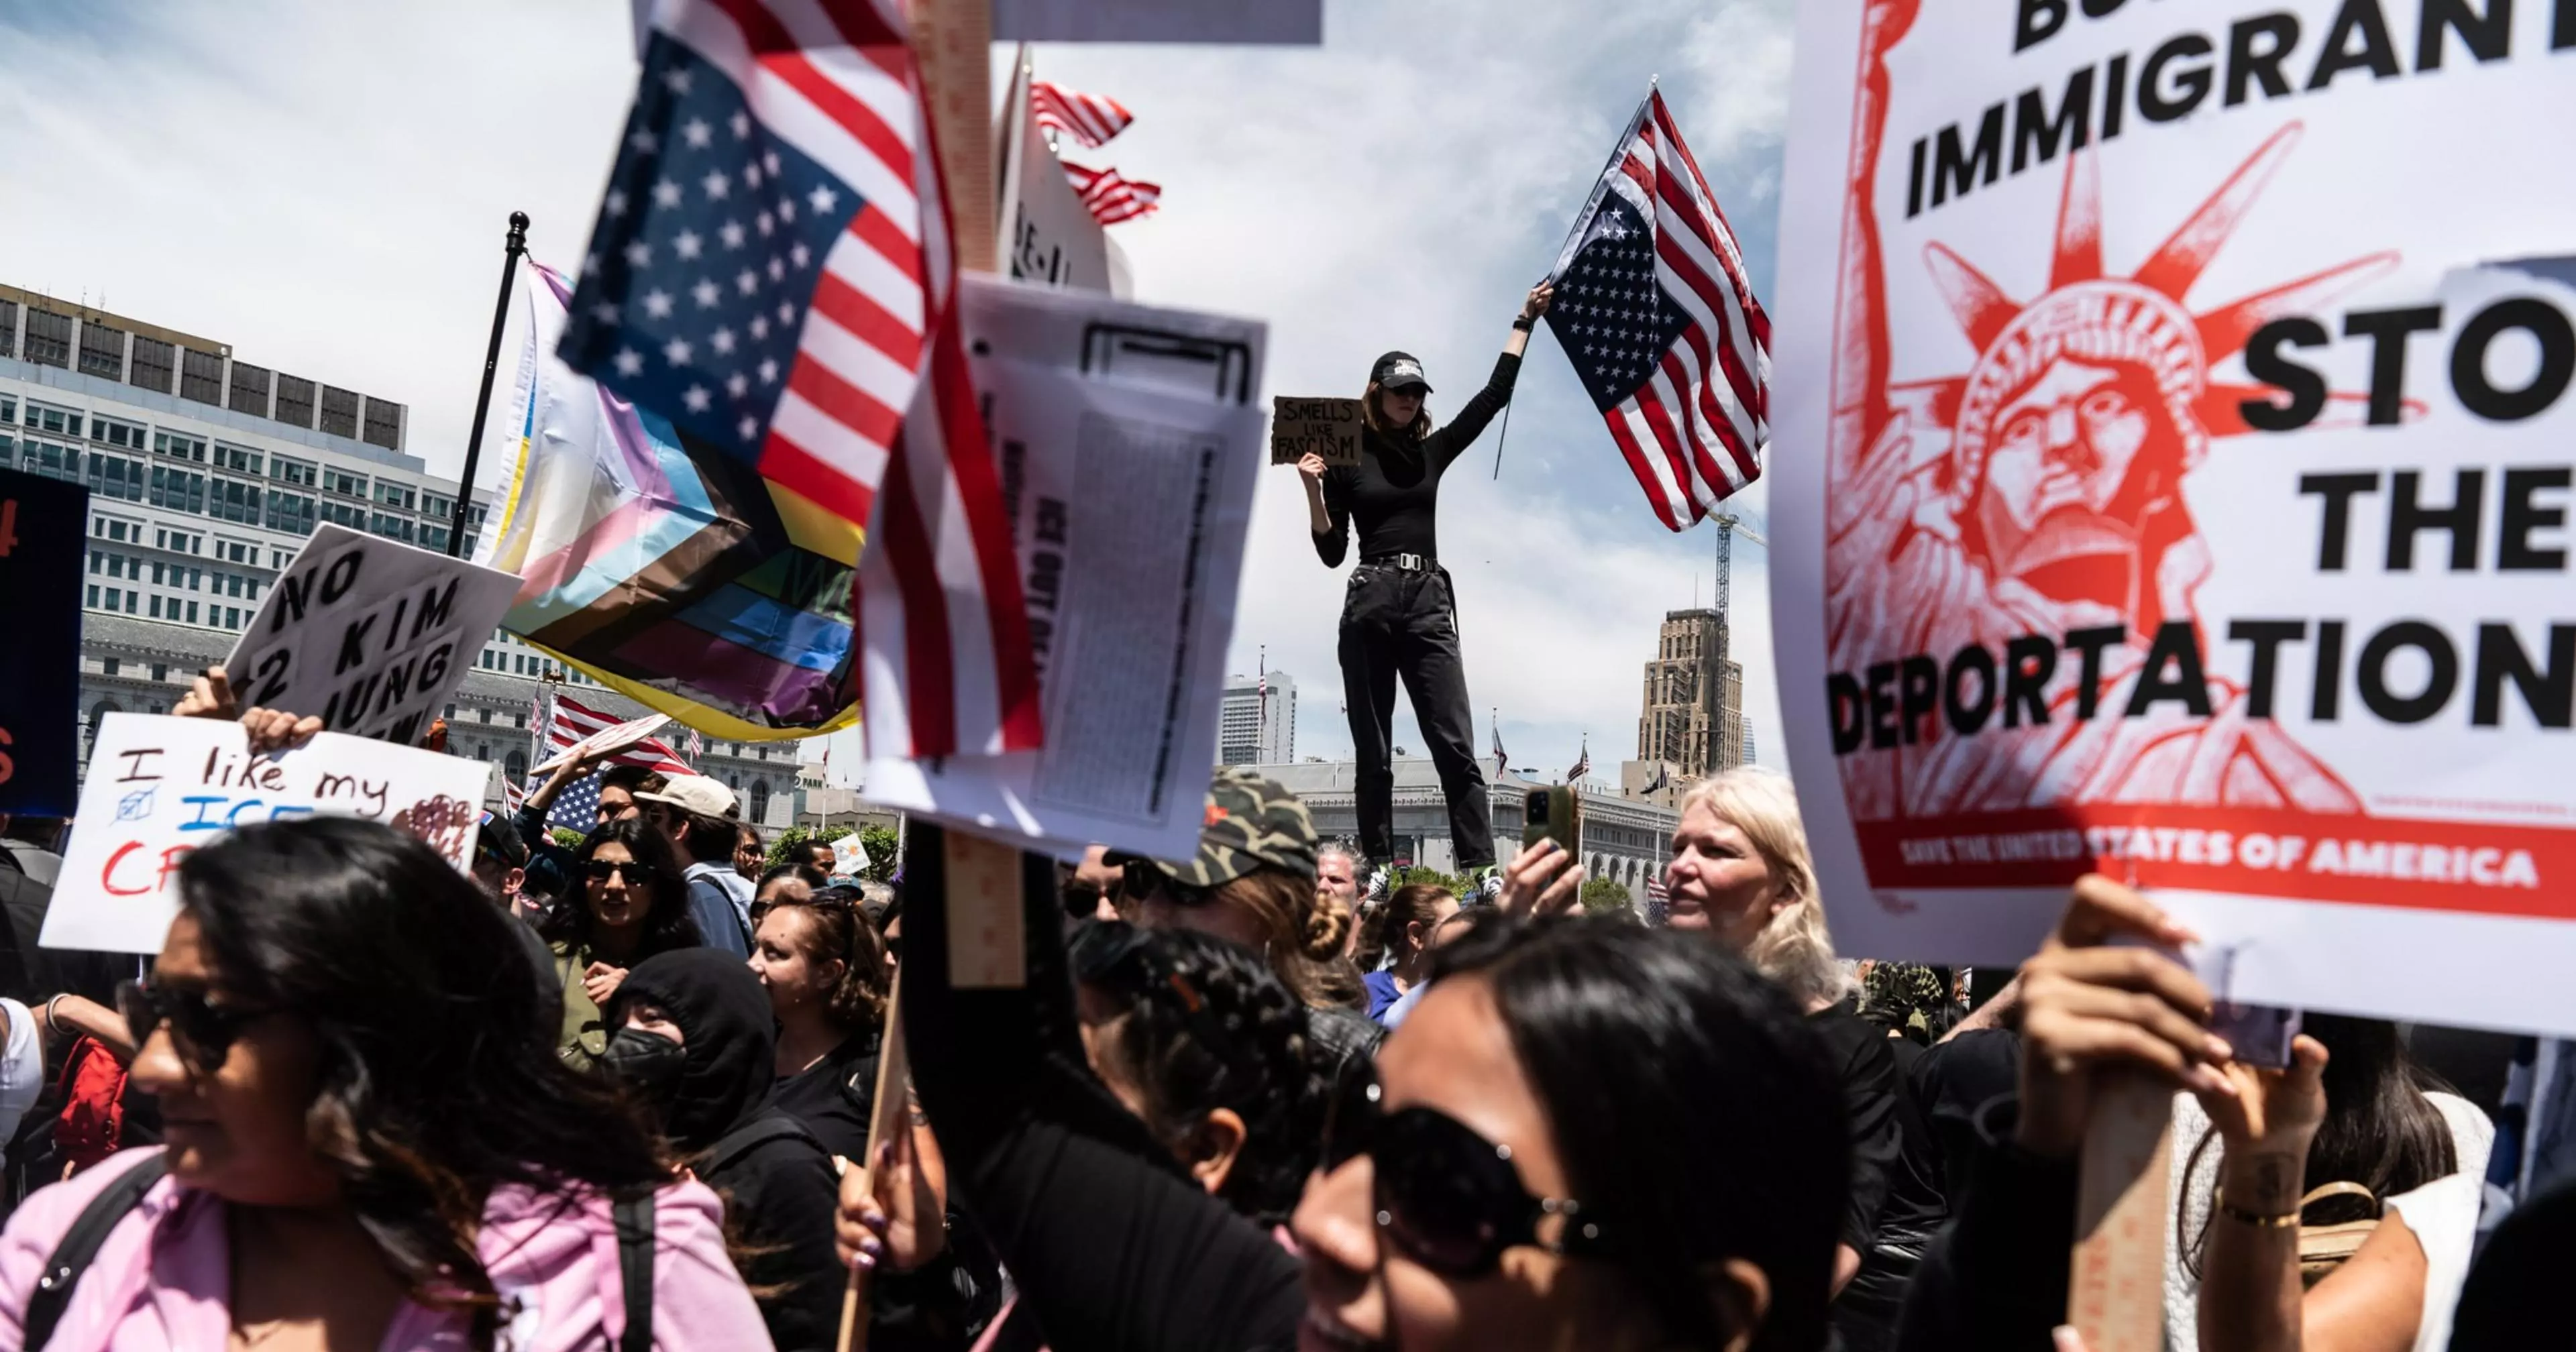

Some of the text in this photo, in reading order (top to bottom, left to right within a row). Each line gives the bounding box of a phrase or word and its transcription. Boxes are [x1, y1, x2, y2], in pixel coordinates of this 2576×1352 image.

[1905, 0, 2576, 220] IMMIGRAN
[1283, 400, 1354, 422] SMELLS
[1304, 422, 1333, 436] LIKE
[1276, 437, 1354, 459] FASCISM
[2298, 467, 2573, 571] THE
[272, 551, 364, 633] NO
[335, 577, 460, 677] KIM
[254, 649, 291, 708] 2
[116, 746, 389, 817] I like my
[803, 778, 823, 789] PARK
[1996, 828, 2084, 858] UNITED
[2087, 826, 2233, 867] STATES
[2239, 834, 2306, 870] OF
[2308, 838, 2540, 889] AMERICA
